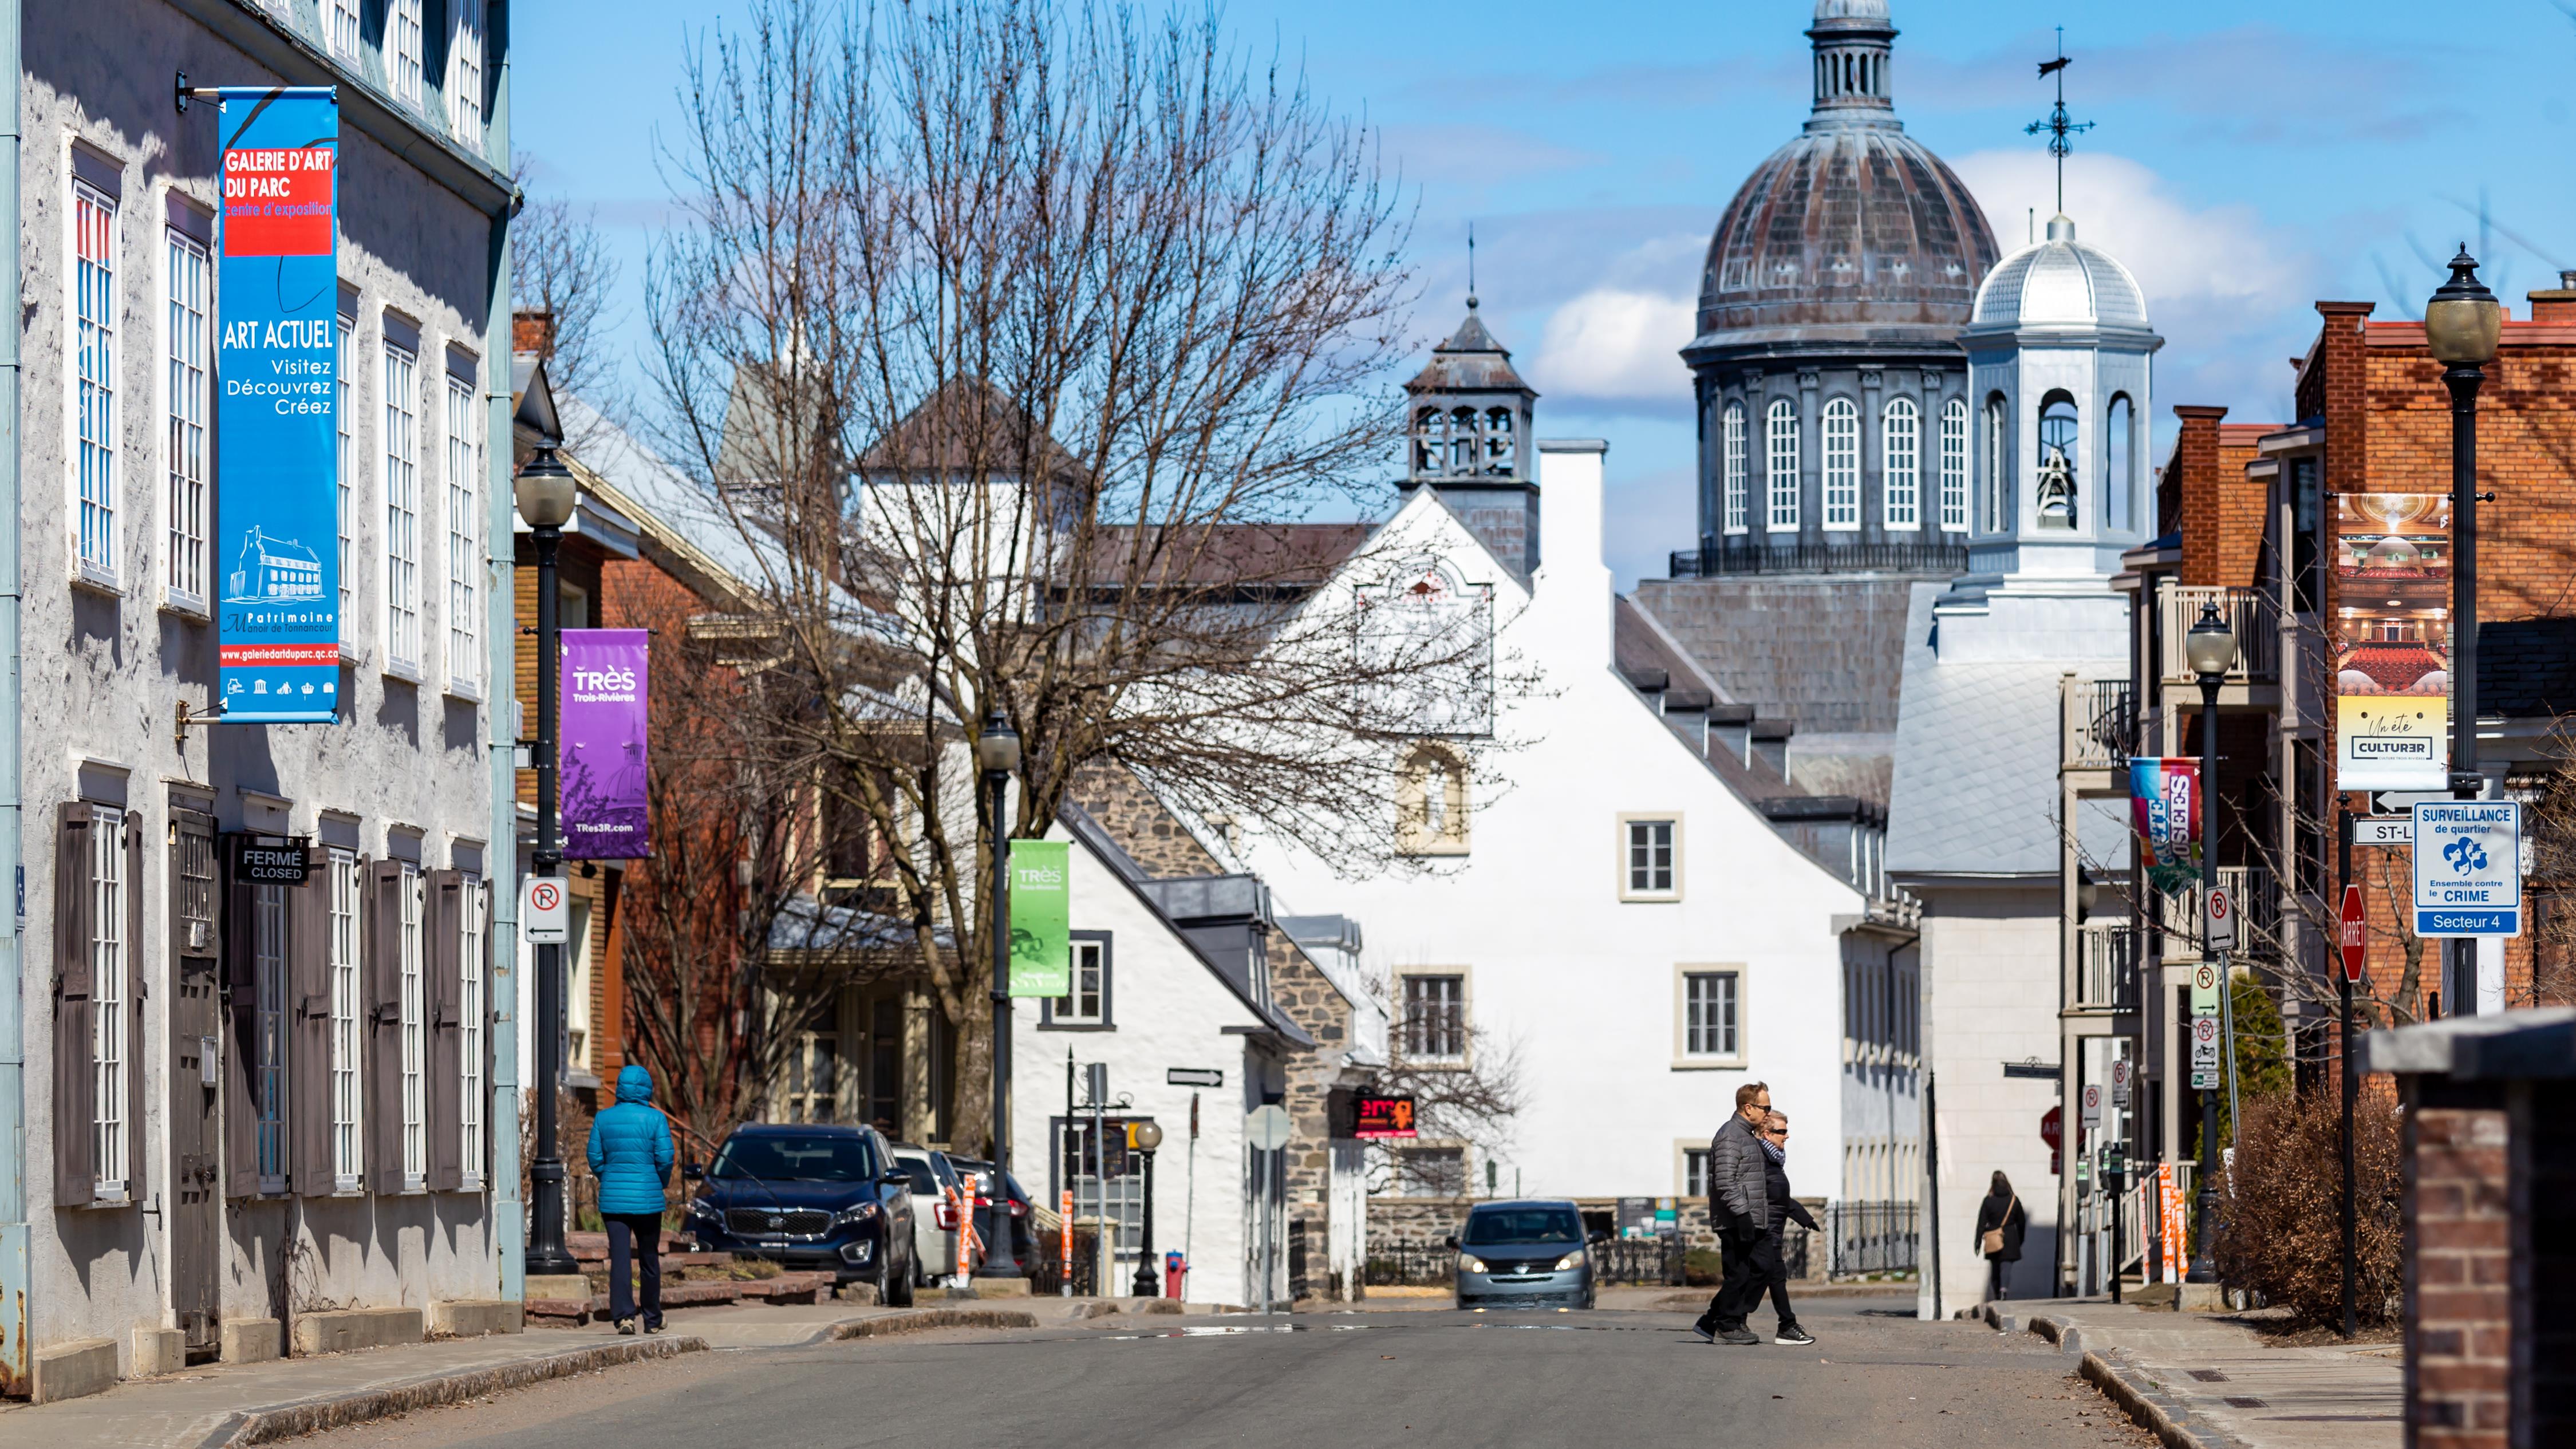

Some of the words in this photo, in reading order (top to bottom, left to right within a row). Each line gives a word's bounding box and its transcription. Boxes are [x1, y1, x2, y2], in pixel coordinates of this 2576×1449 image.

[226, 151, 285, 172] GALERIE
[289, 151, 331, 171] D'ART
[226, 178, 246, 198] DU
[250, 177, 290, 198] PARC
[225, 203, 260, 216] centre
[264, 202, 332, 219] d'exposition
[223, 321, 258, 349] ART
[263, 319, 333, 349] ACTUEL
[271, 359, 331, 375] Visitez
[227, 379, 331, 396] Découvrez
[275, 398, 331, 415] Créez
[247, 611, 333, 623] Patrimoine
[271, 624, 282, 632] de
[221, 649, 338, 661] www.galeriedartduparc.qc.ca
[573, 692, 636, 702] Trois-Rivières
[2391, 713, 2412, 733] été
[2422, 809, 2511, 822] SURVEILLANCE
[2435, 824, 2447, 834] de
[2451, 824, 2491, 835] quartier
[244, 850, 302, 866] FERMÉ
[251, 867, 302, 879] CLOSED
[2444, 890, 2489, 902] CRIME
[2433, 915, 2487, 928] Secteur
[2491, 915, 2500, 927] 4
[2342, 915, 2364, 947] ARRÊT
